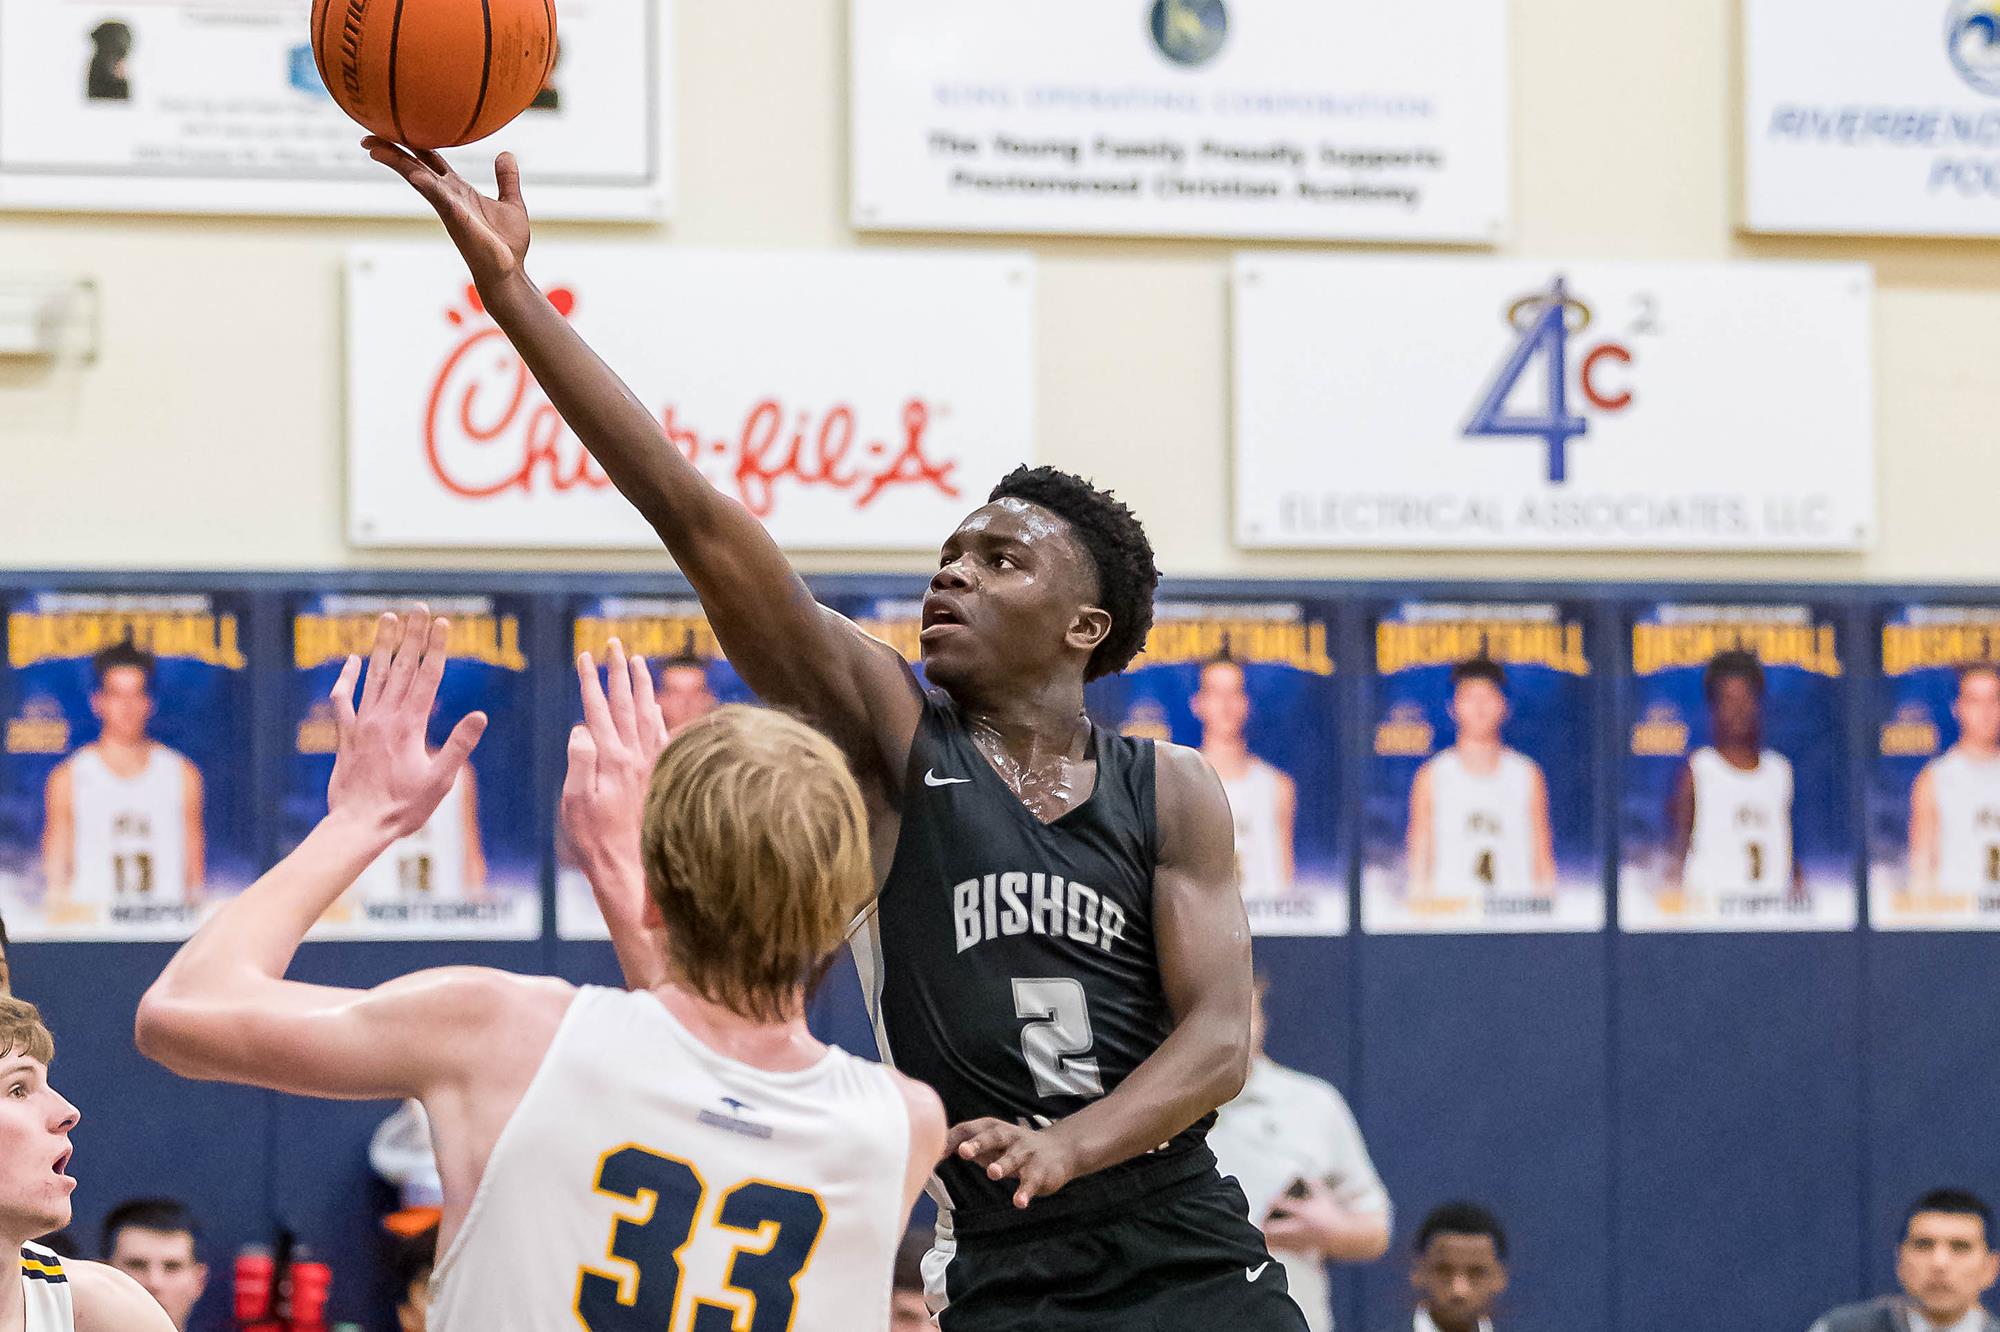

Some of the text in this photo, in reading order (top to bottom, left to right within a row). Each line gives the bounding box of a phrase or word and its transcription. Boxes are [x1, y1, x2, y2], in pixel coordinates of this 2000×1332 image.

[927, 130, 1444, 171] The Young Family Proudly Supports
[1155, 175, 1284, 200] Christian
[1295, 178, 1421, 207] Academy
[422, 325, 962, 518] Chi-fil-A
[1280, 497, 1503, 533] ELECTRICAL
[1764, 499, 1832, 534] LLC
[953, 870, 1128, 955] BISHOP
[1010, 976, 1105, 1100] 2
[572, 1141, 827, 1332] 33
